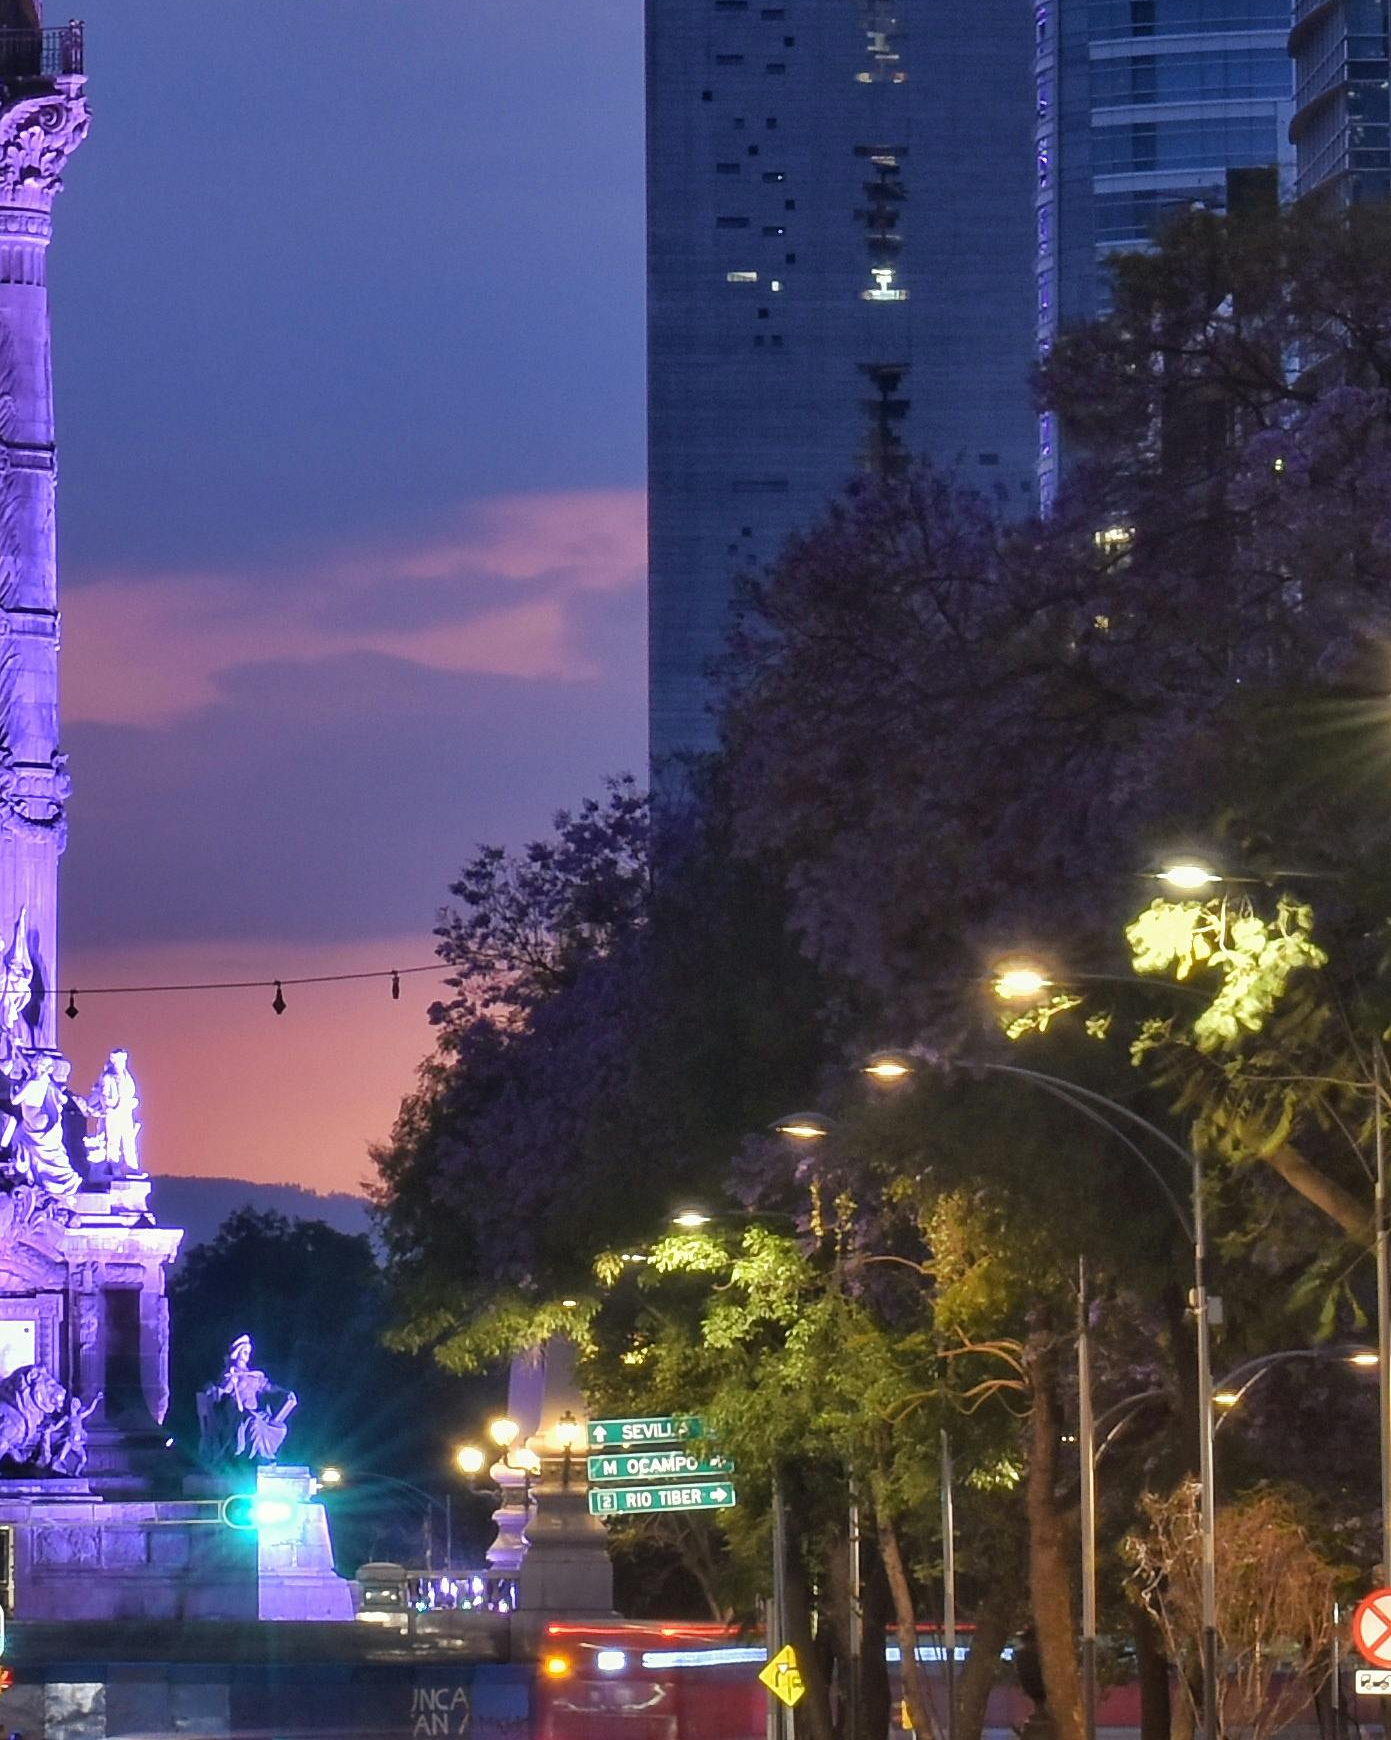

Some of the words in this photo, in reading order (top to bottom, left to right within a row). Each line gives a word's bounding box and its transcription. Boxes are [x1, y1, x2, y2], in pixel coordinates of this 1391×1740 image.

[602, 1459, 618, 1477] M
[626, 1456, 699, 1475] OCAMPO
[601, 1495, 612, 1509] 2
[625, 1492, 653, 1509] RIO
[657, 1488, 702, 1506] TIBER
